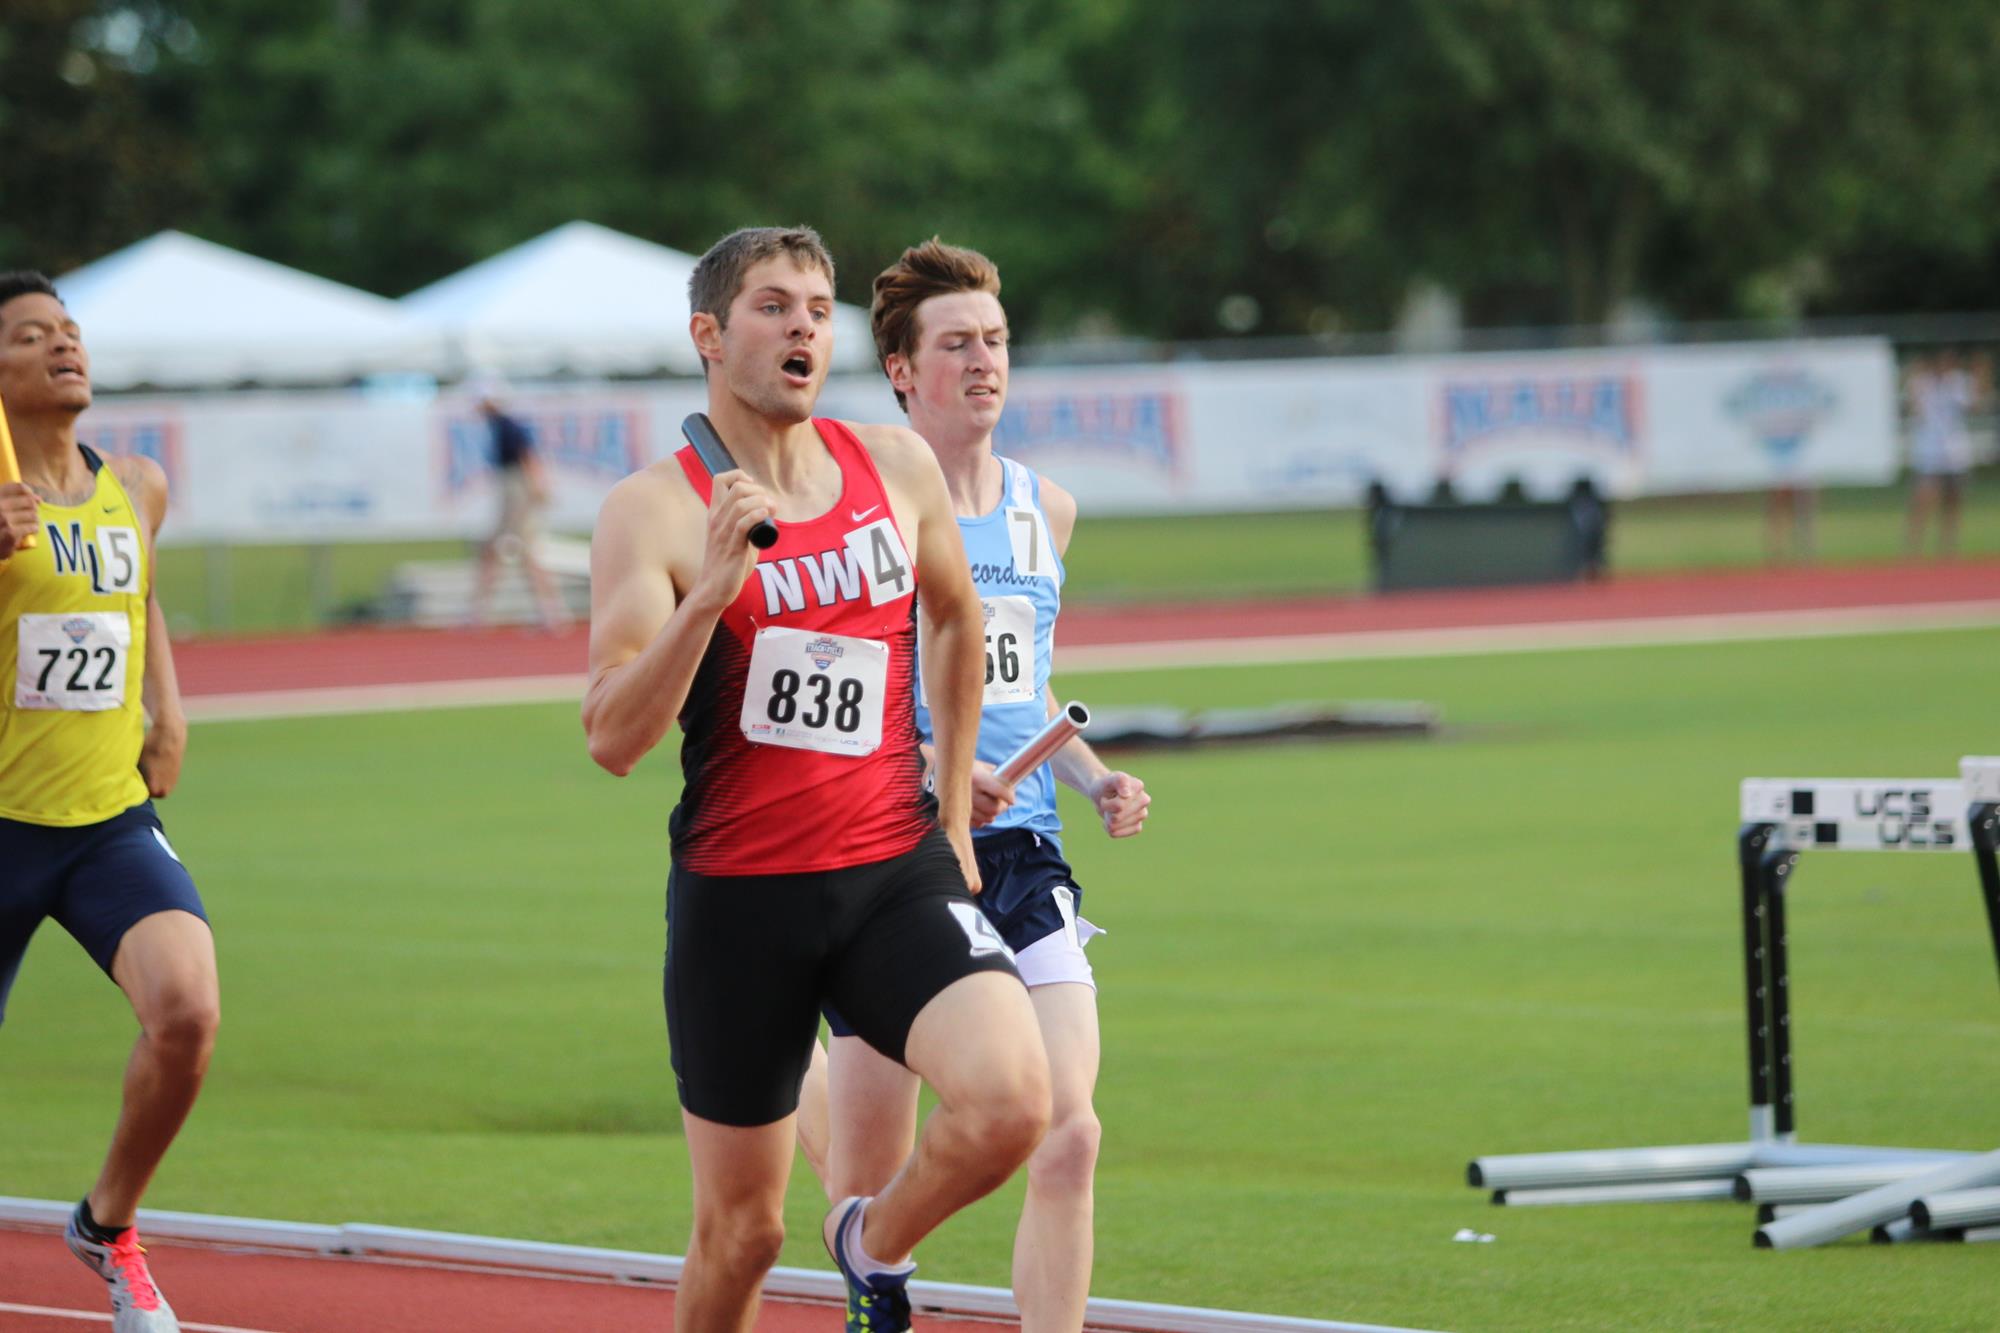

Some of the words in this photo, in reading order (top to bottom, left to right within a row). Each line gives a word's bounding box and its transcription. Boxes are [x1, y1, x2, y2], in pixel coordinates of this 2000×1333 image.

[107, 532, 132, 588] 5
[870, 526, 906, 592] 4
[1013, 511, 1038, 572] 7
[755, 546, 861, 618] NW
[37, 647, 117, 692] 722
[767, 669, 863, 733] 838
[1855, 791, 1931, 816] UCS
